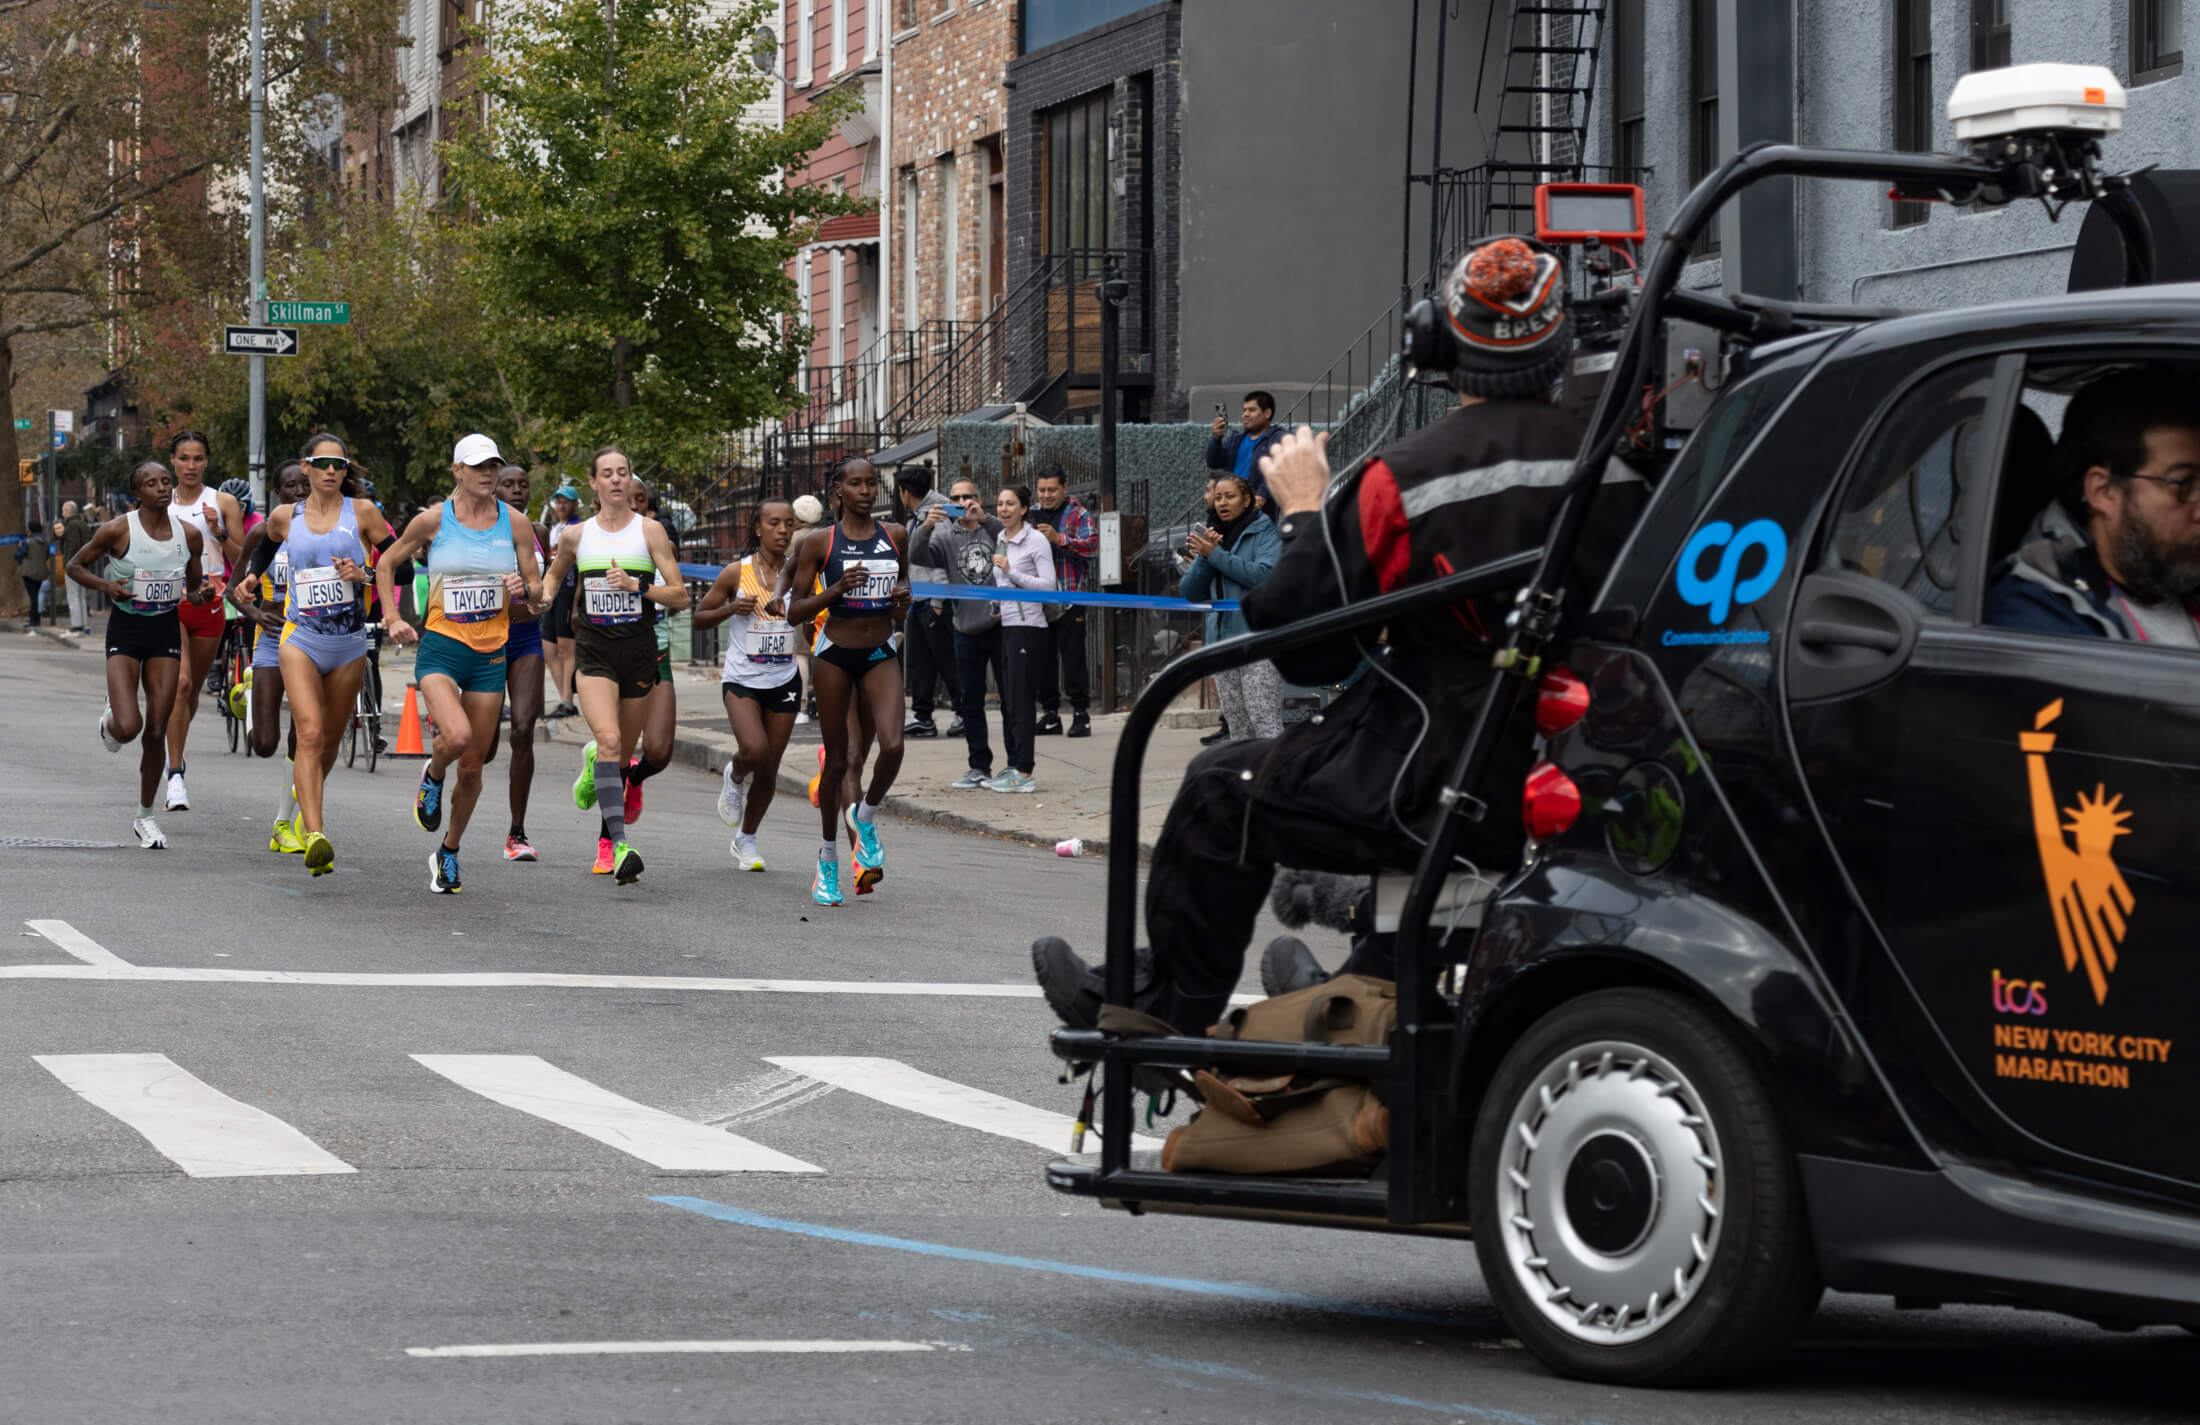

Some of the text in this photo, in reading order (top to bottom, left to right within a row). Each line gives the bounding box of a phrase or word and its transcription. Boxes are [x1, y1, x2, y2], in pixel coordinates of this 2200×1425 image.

[272, 304, 344, 321] Skillman St
[236, 335, 286, 347] ONE WAY
[146, 583, 174, 601] OBIRI
[307, 582, 344, 605] JESUS
[452, 589, 496, 611] TAYLOR
[591, 592, 636, 613] HUDDLE
[758, 635, 785, 654] JIFAR
[1992, 968, 2048, 1016] tcs
[1994, 1024, 2173, 1063] NEW YORK CITY
[1995, 1054, 2130, 1089] MARATHON
